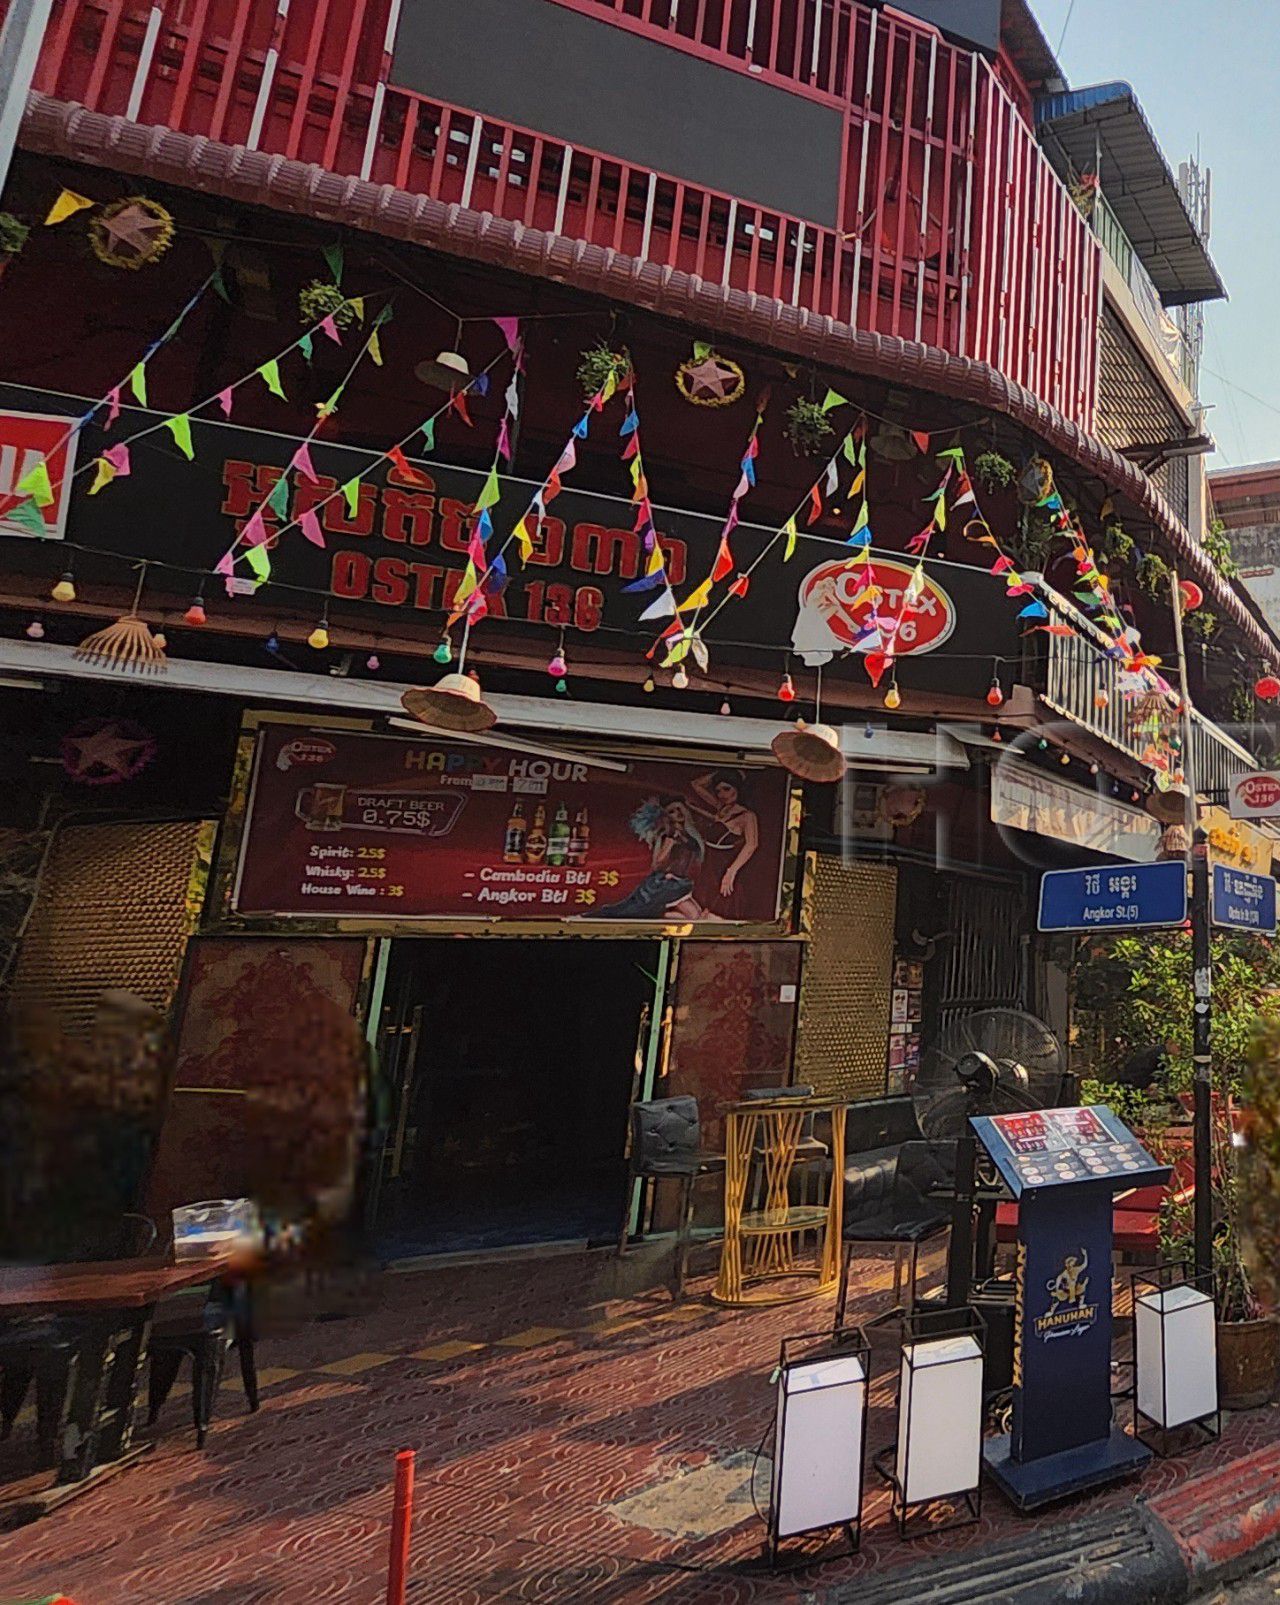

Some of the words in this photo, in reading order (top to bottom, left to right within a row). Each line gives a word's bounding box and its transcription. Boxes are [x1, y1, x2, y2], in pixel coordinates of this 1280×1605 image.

[525, 579, 604, 632] 136
[404, 751, 503, 773] HAPPY
[508, 759, 588, 782] HOUR
[357, 797, 405, 809] DRAFT
[409, 800, 445, 812] BEER
[1254, 793, 1275, 803] 136
[363, 809, 431, 829] 0.75$
[309, 845, 354, 860] Spirit:
[305, 864, 354, 880] Whisky:
[480, 868, 561, 884] Cambodia
[598, 870, 619, 887] 3$
[301, 883, 342, 895] House
[346, 884, 376, 896] Wine
[478, 887, 536, 904] Angkor
[575, 889, 596, 905] 3$
[1083, 906, 1115, 922] Angkor
